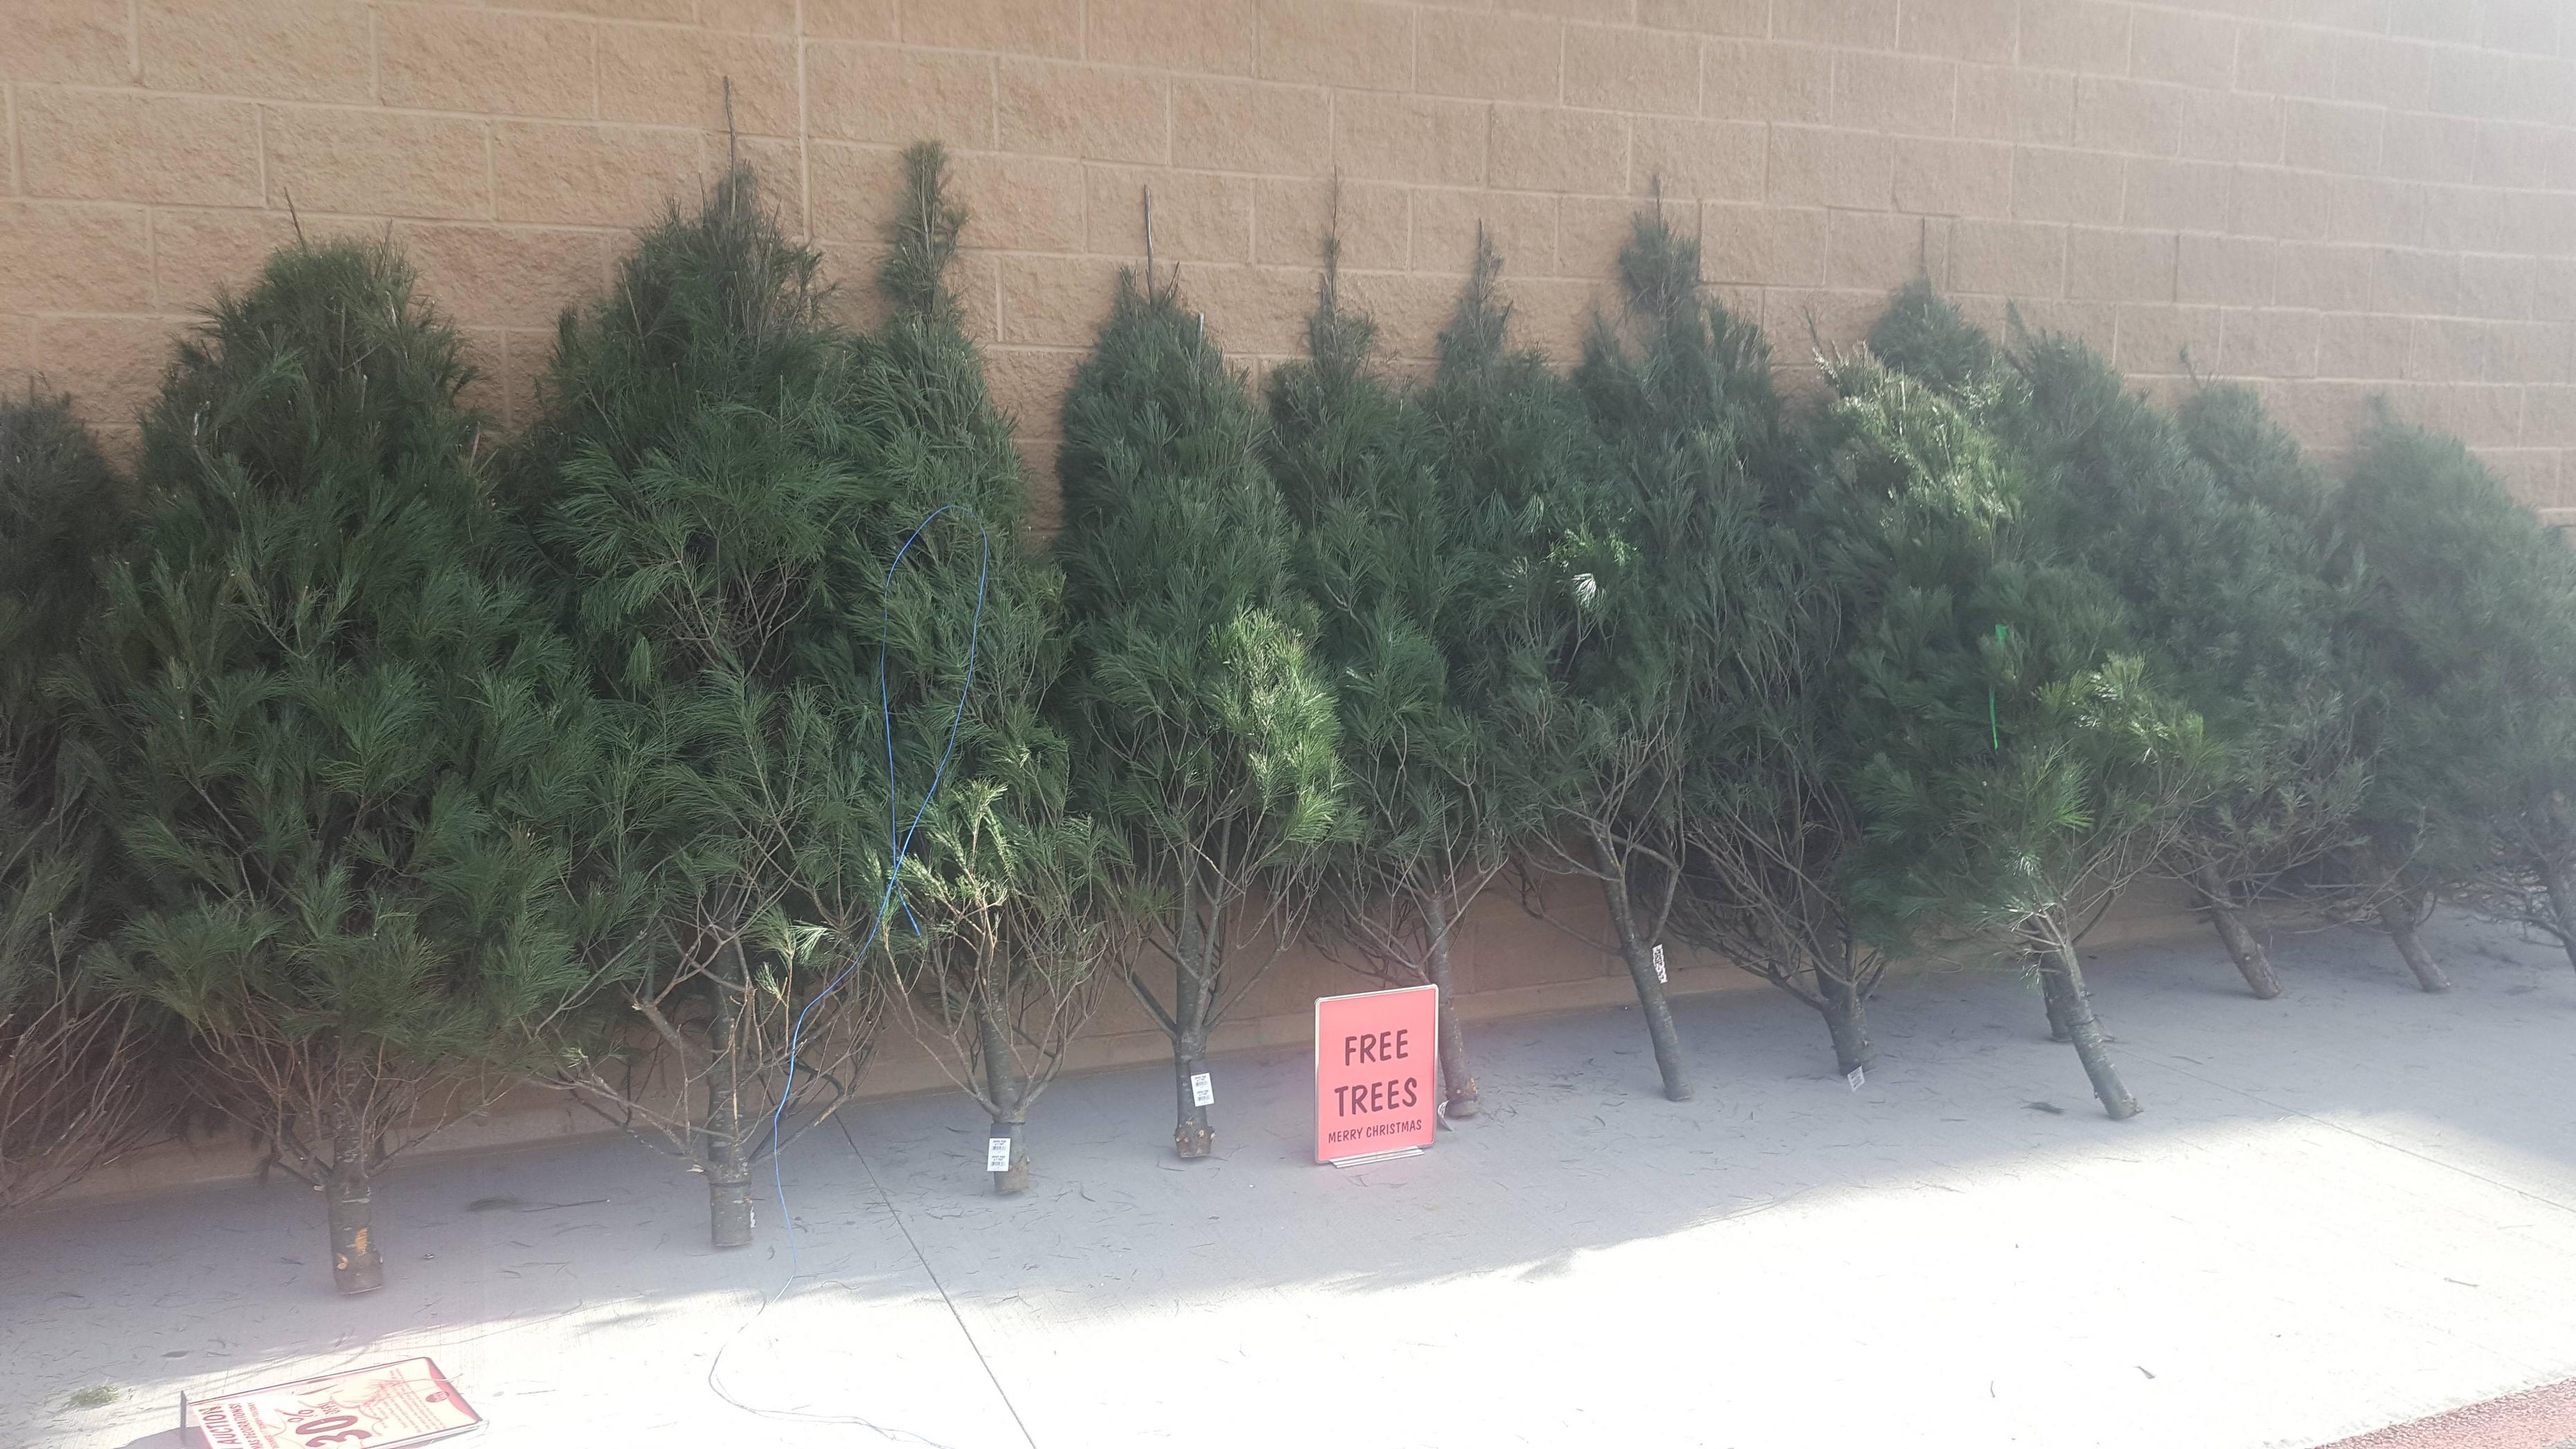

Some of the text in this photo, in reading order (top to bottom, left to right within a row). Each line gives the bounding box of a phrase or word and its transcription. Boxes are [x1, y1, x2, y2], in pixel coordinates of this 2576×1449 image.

[1345, 1029, 1409, 1066] FREE
[1334, 1076, 1418, 1117] TREES
[1328, 1119, 1422, 1144] MERRY CHRISTMAS
[198, 1405, 242, 1445] AUCTION
